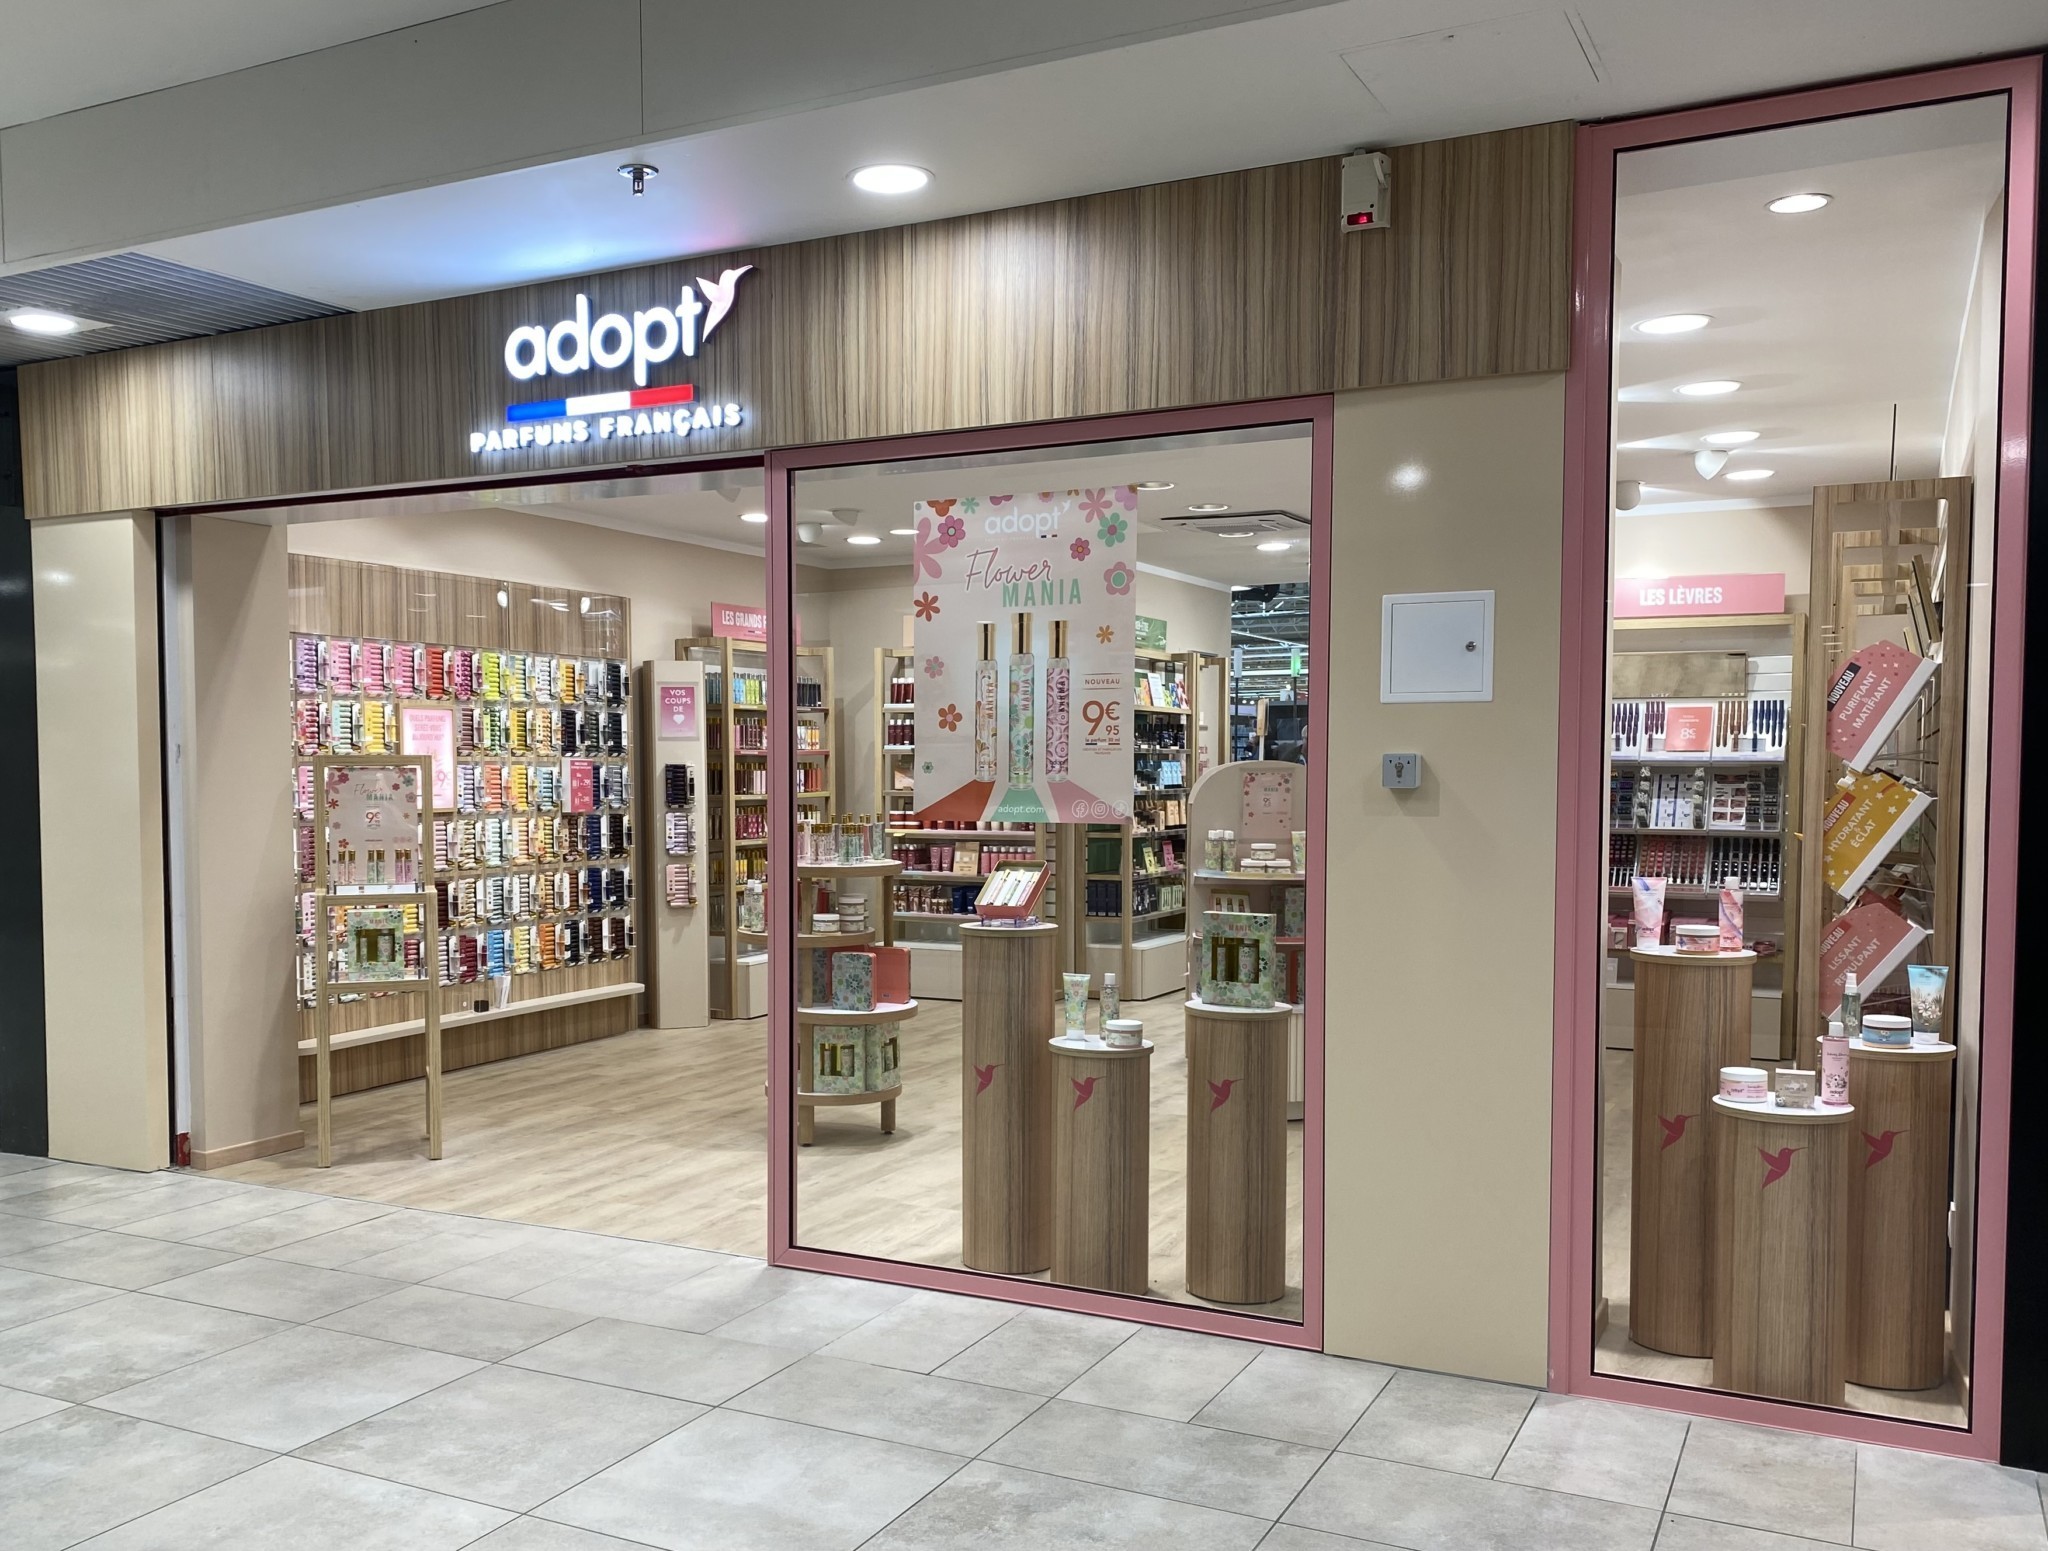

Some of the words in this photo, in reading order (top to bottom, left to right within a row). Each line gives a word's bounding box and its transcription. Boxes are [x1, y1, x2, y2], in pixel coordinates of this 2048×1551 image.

[504, 285, 703, 387] adopt
[469, 420, 590, 453] PARFUMS
[599, 402, 743, 439] FRANÇAIS
[984, 505, 1061, 539] adopt
[965, 547, 1052, 592] Flower
[1002, 578, 1082, 608] MANIA
[1639, 588, 1666, 606] LES
[1669, 585, 1723, 605] LÈVRES
[722, 610, 734, 626] LES
[735, 611, 762, 628] GRANDS
[664, 697, 692, 705] COUPS
[1021, 678, 1030, 711] MANIA
[1827, 670, 1855, 704] NOUVEAU
[1839, 670, 1877, 721] PURIFIANT
[1852, 677, 1892, 729] MATIFIANT
[673, 705, 684, 713] DE
[1105, 724, 1120, 736] 95
[998, 804, 1044, 815] adopt.com
[1827, 798, 1873, 852] HYDRATANT
[1828, 935, 1862, 970] LISSANT
